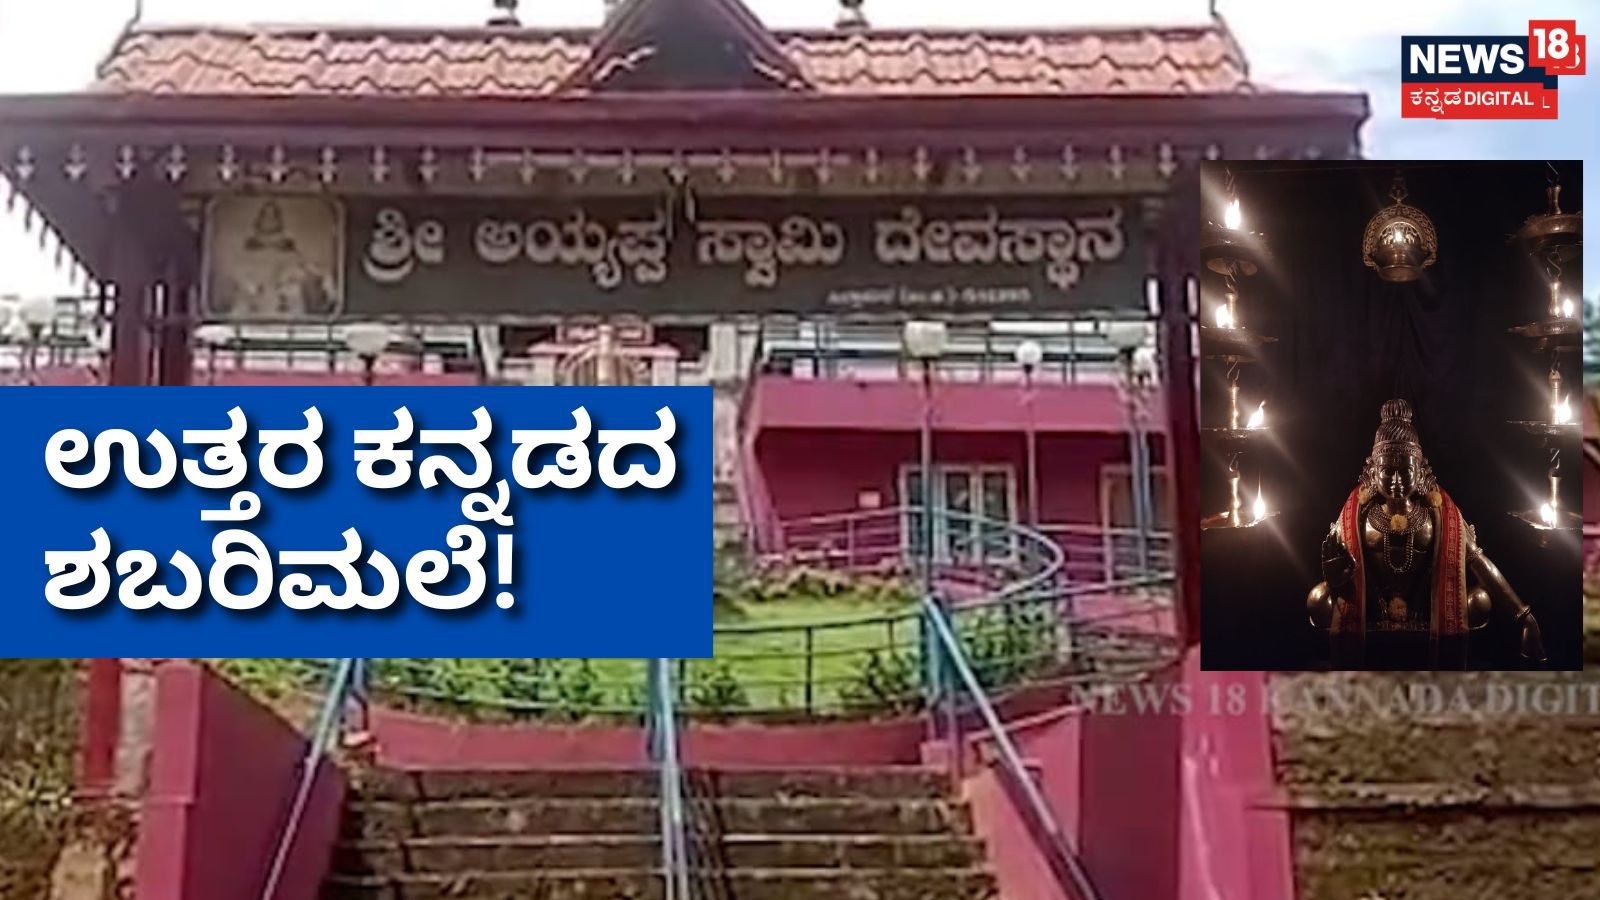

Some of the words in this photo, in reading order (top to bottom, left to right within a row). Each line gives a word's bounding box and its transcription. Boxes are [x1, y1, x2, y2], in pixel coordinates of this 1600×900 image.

[363, 208, 446, 282] ಶ್ರೀ
[475, 207, 668, 288] ಅಯ್ಯಪ್ಪ
[696, 212, 846, 288] ಸ್ವಾಮಿ
[874, 205, 1125, 289] ದೇವಸ್ಥಾನ
